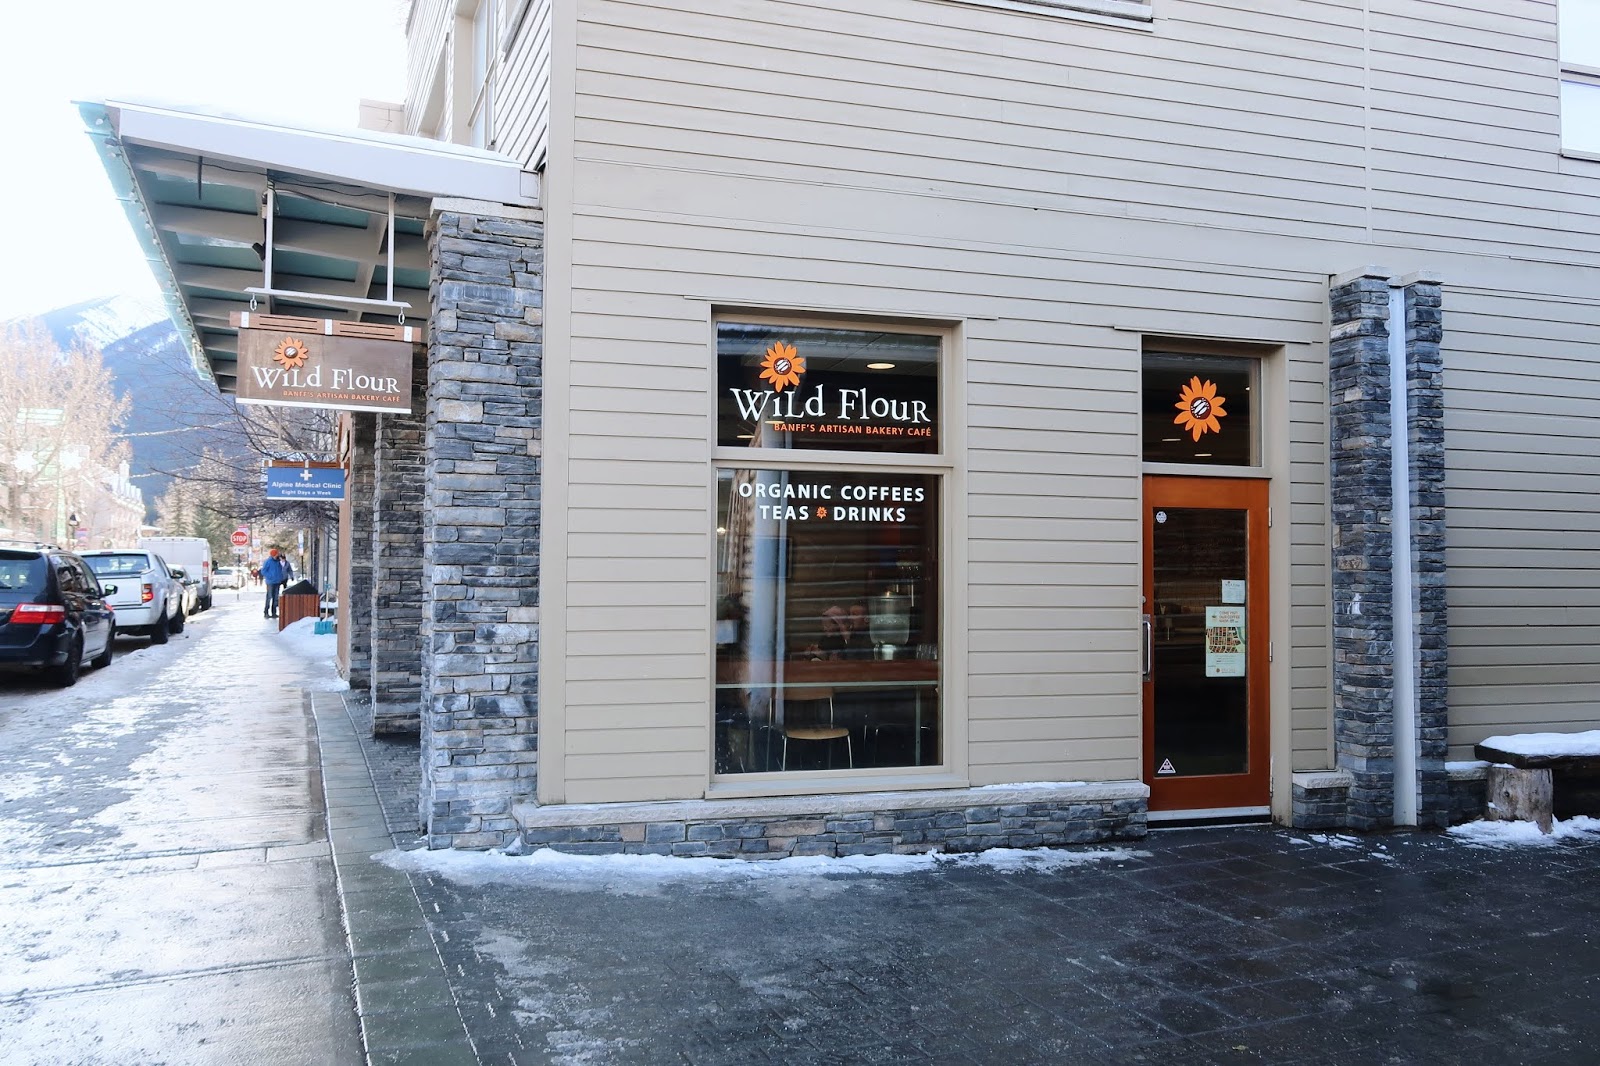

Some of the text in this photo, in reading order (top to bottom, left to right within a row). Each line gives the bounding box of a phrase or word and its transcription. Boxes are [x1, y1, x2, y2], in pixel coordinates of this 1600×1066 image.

[773, 423, 931, 436] BANFF'S ARTISAN BAKERY CAFÉ
[271, 481, 293, 489] Alpine
[738, 483, 925, 502] ORGANIC COFFEES
[759, 505, 906, 522] TEAS DRINKS
[232, 534, 247, 542] STOP
